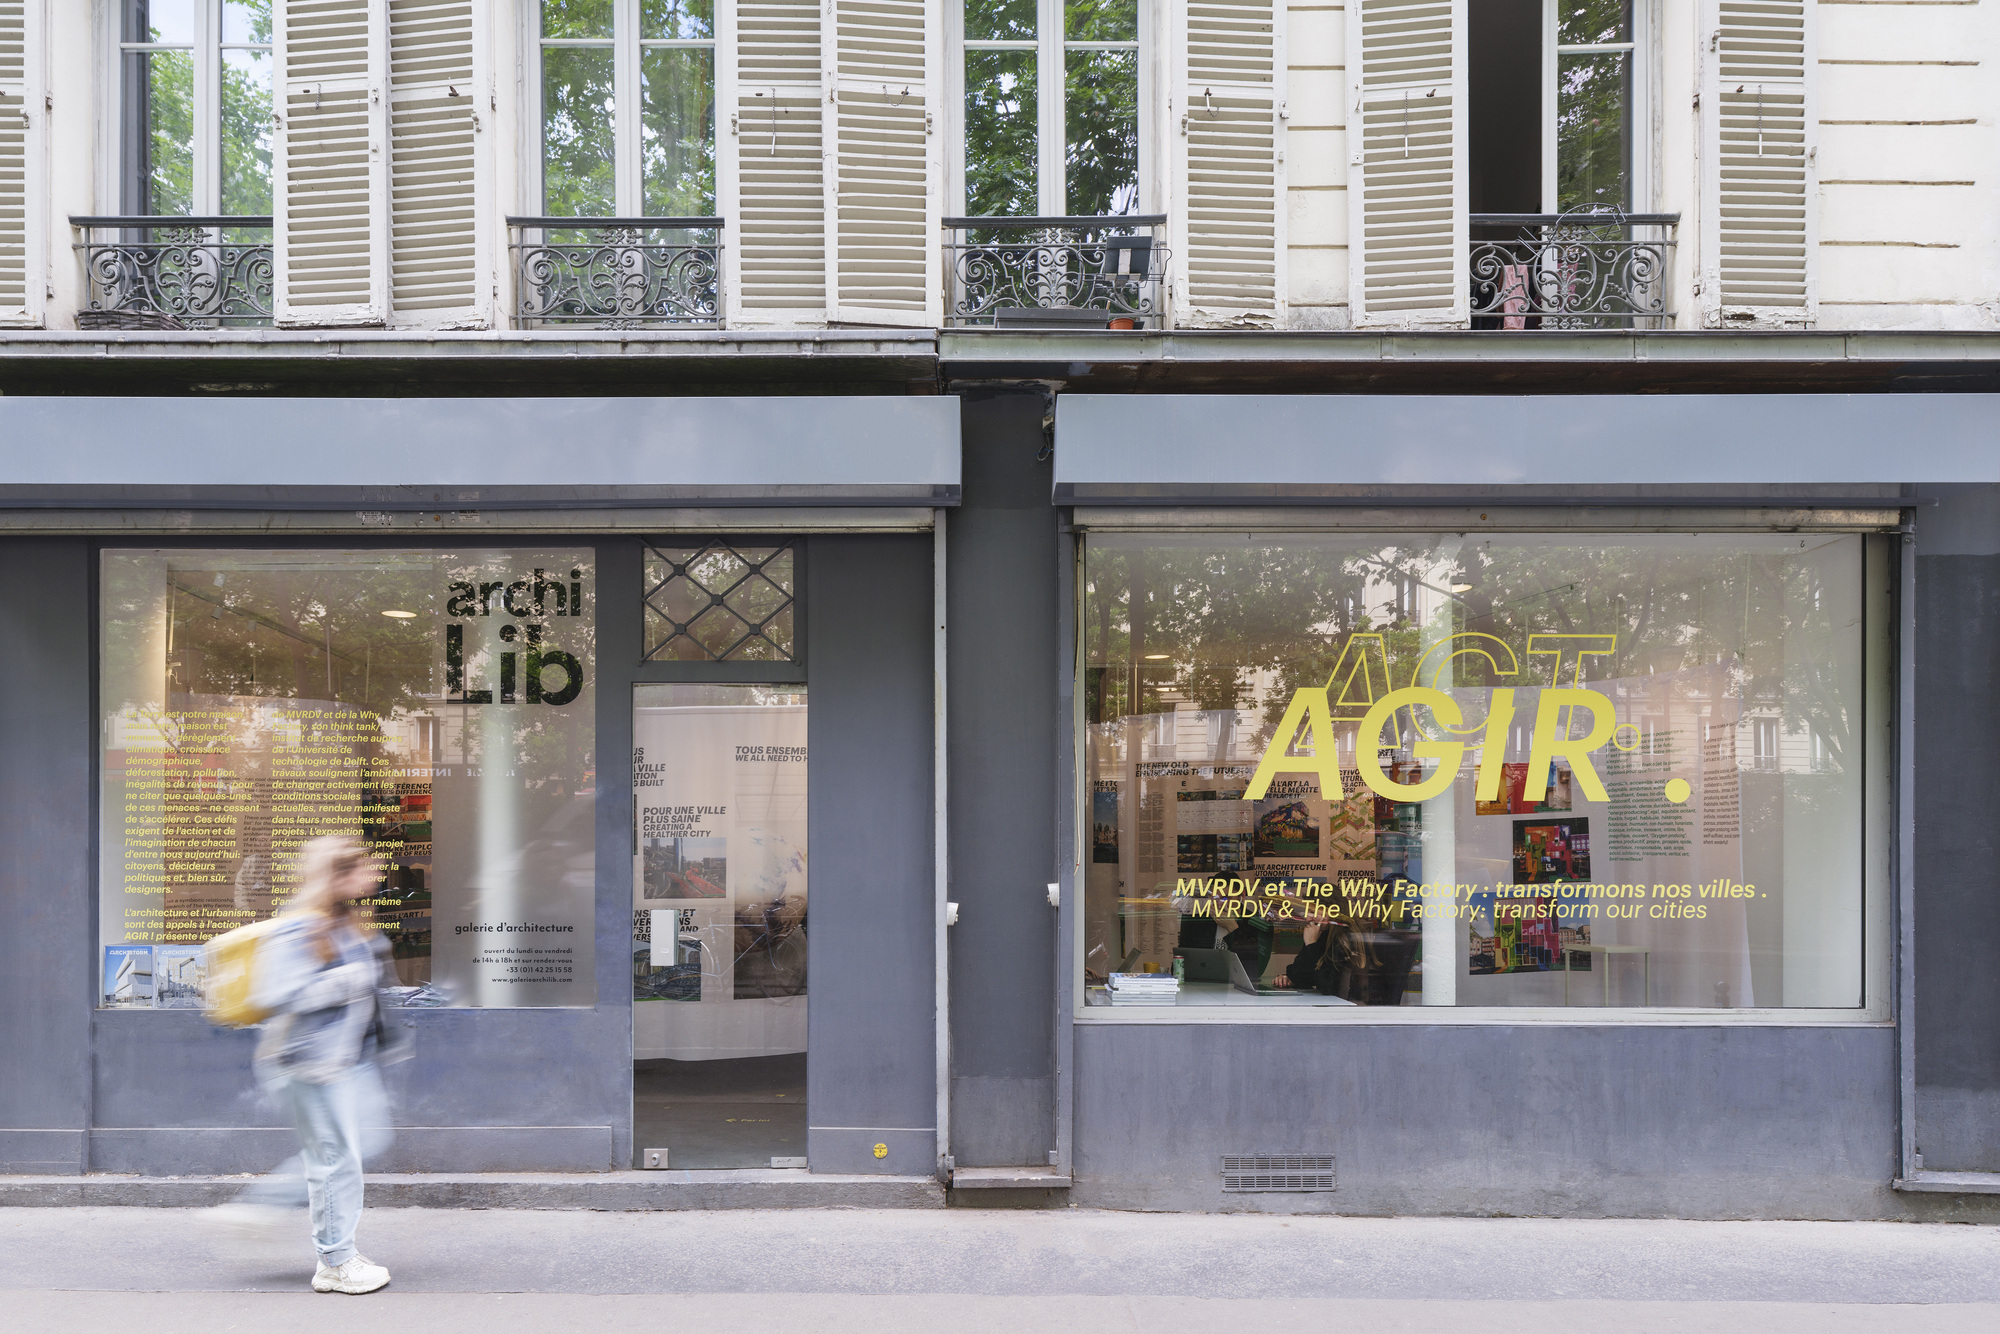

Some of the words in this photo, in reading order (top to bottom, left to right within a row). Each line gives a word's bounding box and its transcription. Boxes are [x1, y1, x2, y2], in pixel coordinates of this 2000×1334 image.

[446, 568, 581, 617] archi
[446, 624, 584, 706] Lib
[272, 710, 284, 718] de
[286, 710, 322, 718] MVRDV
[324, 710, 333, 718] et
[335, 710, 347, 718] de
[349, 710, 357, 718] la
[359, 710, 380, 720] Why
[272, 722, 309, 732] Factory,
[330, 722, 354, 730] think
[356, 722, 380, 730] tank/
[272, 734, 305, 742] institut
[307, 734, 318, 742] de
[321, 734, 368, 742] recherche
[370, 734, 402, 744] auprès
[126, 745, 178, 755] climatique,
[180, 745, 230, 753] croissance
[272, 745, 284, 753] de
[286, 745, 338, 753] l'Université
[340, 745, 352, 753] de
[735, 746, 764, 754] TOUS
[126, 756, 203, 766] démographique,
[272, 757, 327, 767] technologie
[330, 757, 342, 765] de
[344, 757, 368, 765] Delft.
[371, 757, 389, 765] Ces
[126, 768, 191, 778] déforestation,
[193, 768, 237, 778] pollution,
[638, 764, 666, 772] VILLE
[272, 769, 306, 777] travaux
[309, 769, 358, 779] soulignent
[126, 780, 171, 790] inégalités
[173, 780, 185, 788] de
[232, 782, 254, 790] pour
[272, 780, 284, 788] de
[286, 780, 324, 790] changer
[326, 780, 378, 788] activement
[381, 780, 394, 788] les
[1288, 785, 1318, 793] MÉRITE
[140, 792, 161, 800] citer
[163, 793, 181, 802] que
[183, 792, 252, 802] quelques-unes
[272, 792, 321, 800] conditions
[323, 792, 361, 800] sociales
[125, 803, 138, 811] de
[224, 803, 260, 811] cessent
[272, 804, 316, 813] actuelles,
[318, 804, 352, 812] rendue
[354, 804, 400, 812] manifeste
[643, 807, 672, 815] POUR
[674, 807, 694, 815] UNE
[697, 806, 726, 814] VILLE
[125, 815, 138, 823] de
[194, 815, 213, 823] Ces
[215, 815, 237, 823] défis
[272, 815, 294, 823] dans
[296, 815, 319, 823] leurs
[322, 815, 374, 823] recherches
[376, 815, 386, 823] et
[643, 815, 669, 824] PLUS
[671, 815, 701, 823] SAINE
[125, 827, 160, 836] exigent
[162, 827, 174, 835] de
[212, 827, 222, 835] et
[223, 827, 236, 835] de
[272, 827, 307, 837] projets.
[187, 839, 199, 847] de
[201, 839, 236, 847] chacun
[125, 862, 166, 872] citoyens,
[169, 862, 216, 870] décideurs
[124, 873, 171, 883] politiques
[173, 873, 185, 883] et,
[188, 873, 208, 881] bien
[210, 873, 227, 883] sûr,
[124, 885, 173, 895] designers.
[1175, 879, 1260, 897] MVRDV
[1264, 881, 1286, 897] et
[1293, 878, 1333, 897] The
[1340, 878, 1388, 902] Why
[1393, 879, 1478, 902] Factory
[1496, 879, 1646, 897] transformons
[1652, 884, 1692, 897] nos
[1699, 878, 1756, 897] villes
[190, 908, 199, 916] et
[1192, 900, 1272, 918] MVRDV
[1278, 900, 1294, 918] &
[1302, 899, 1340, 918] The
[1348, 899, 1394, 922] Why
[1400, 900, 1486, 922] Factory:
[1494, 899, 1599, 918] transform
[1606, 904, 1643, 918] our
[1650, 900, 1708, 918] cities
[124, 920, 145, 928] sont
[147, 920, 164, 928] des
[166, 920, 197, 930] appels
[199, 920, 204, 928] à
[455, 923, 494, 935] galerie
[124, 932, 149, 940] AGIR
[156, 932, 197, 942] présente
[200, 932, 212, 940] les
